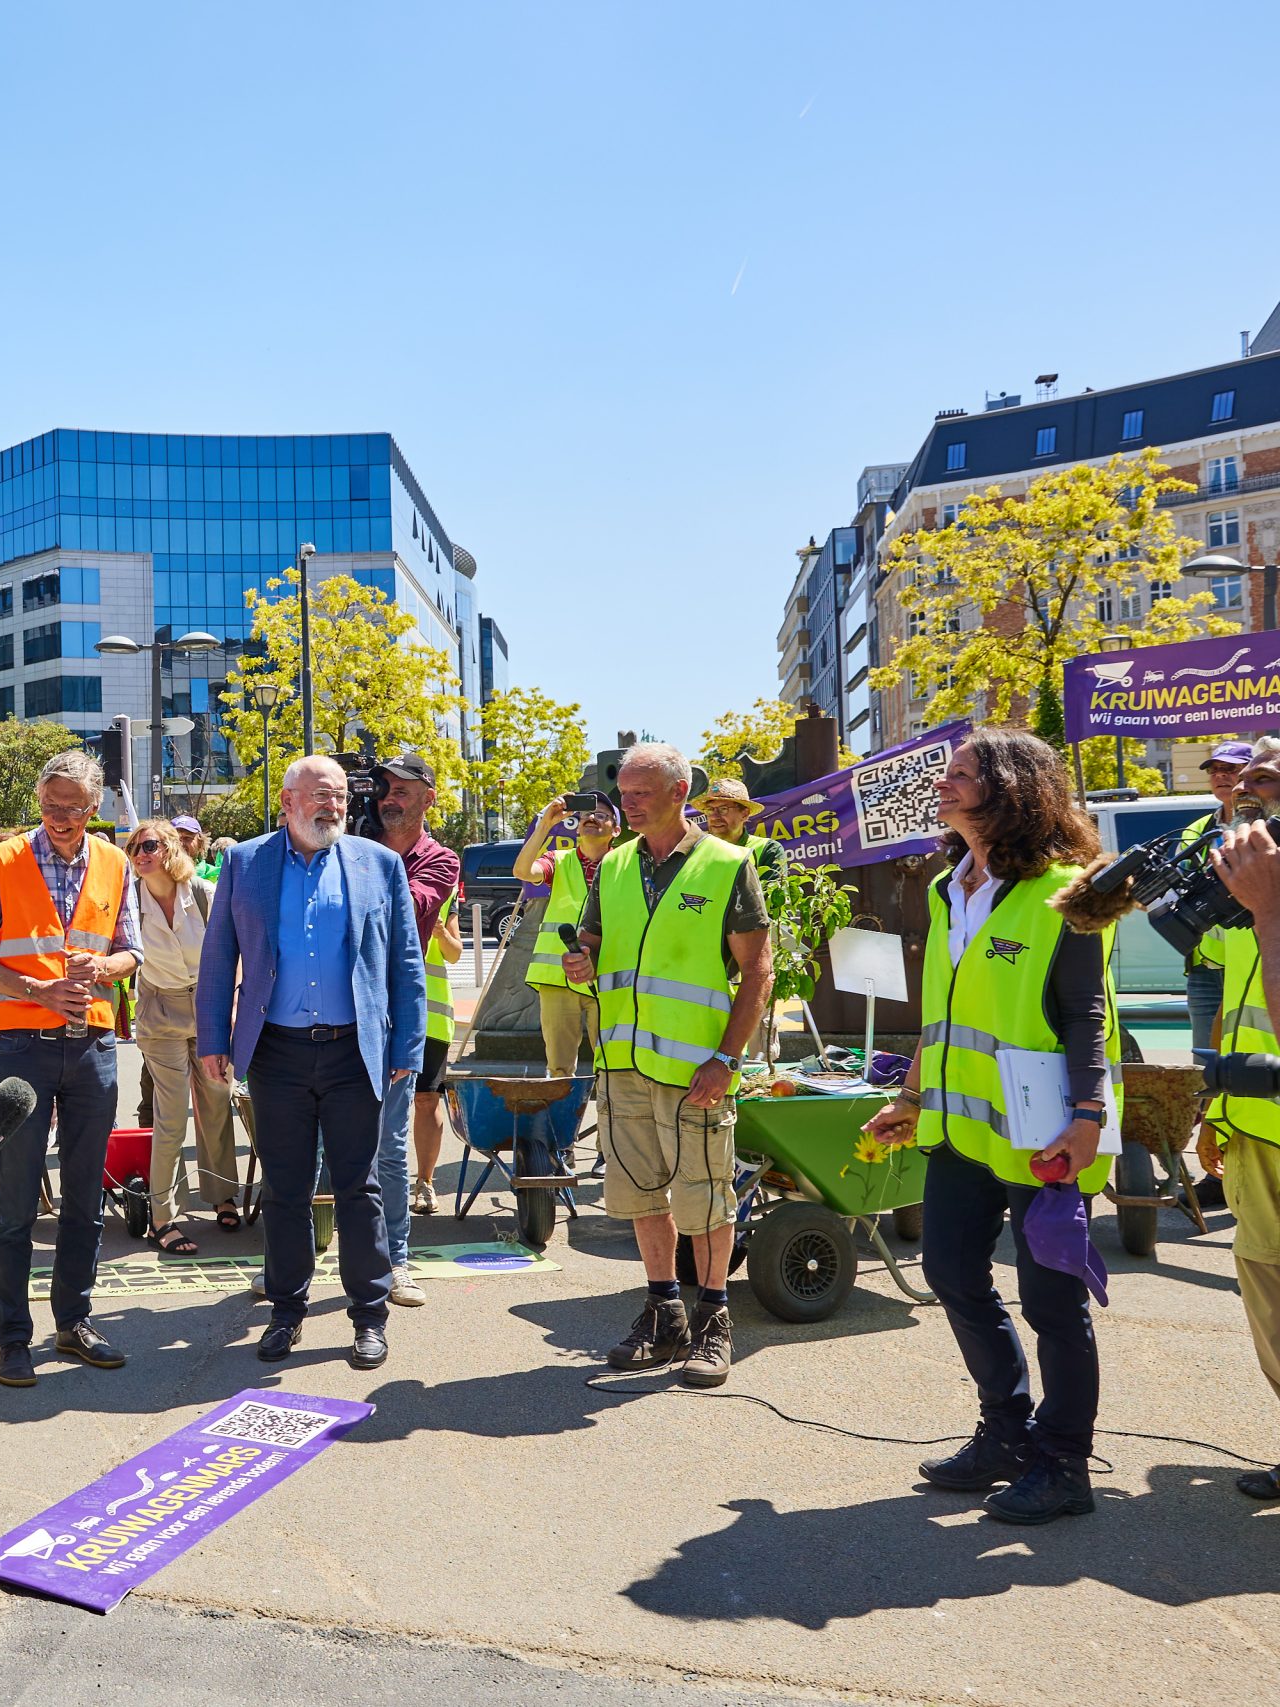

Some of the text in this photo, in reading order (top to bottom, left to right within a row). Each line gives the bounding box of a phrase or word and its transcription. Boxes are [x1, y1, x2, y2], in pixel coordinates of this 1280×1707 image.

[1089, 713, 1111, 725] Wij
[1114, 715, 1150, 726] gaan
[1153, 713, 1182, 725] voor
[1184, 710, 1209, 722] een
[1211, 703, 1263, 720] levende
[55, 1445, 263, 1572] KRUIWAGENMARS
[125, 1538, 166, 1563] gaan
[158, 1519, 191, 1541] voor
[182, 1505, 212, 1523] een
[204, 1475, 253, 1509] levende
[241, 1451, 290, 1479] bodem!
